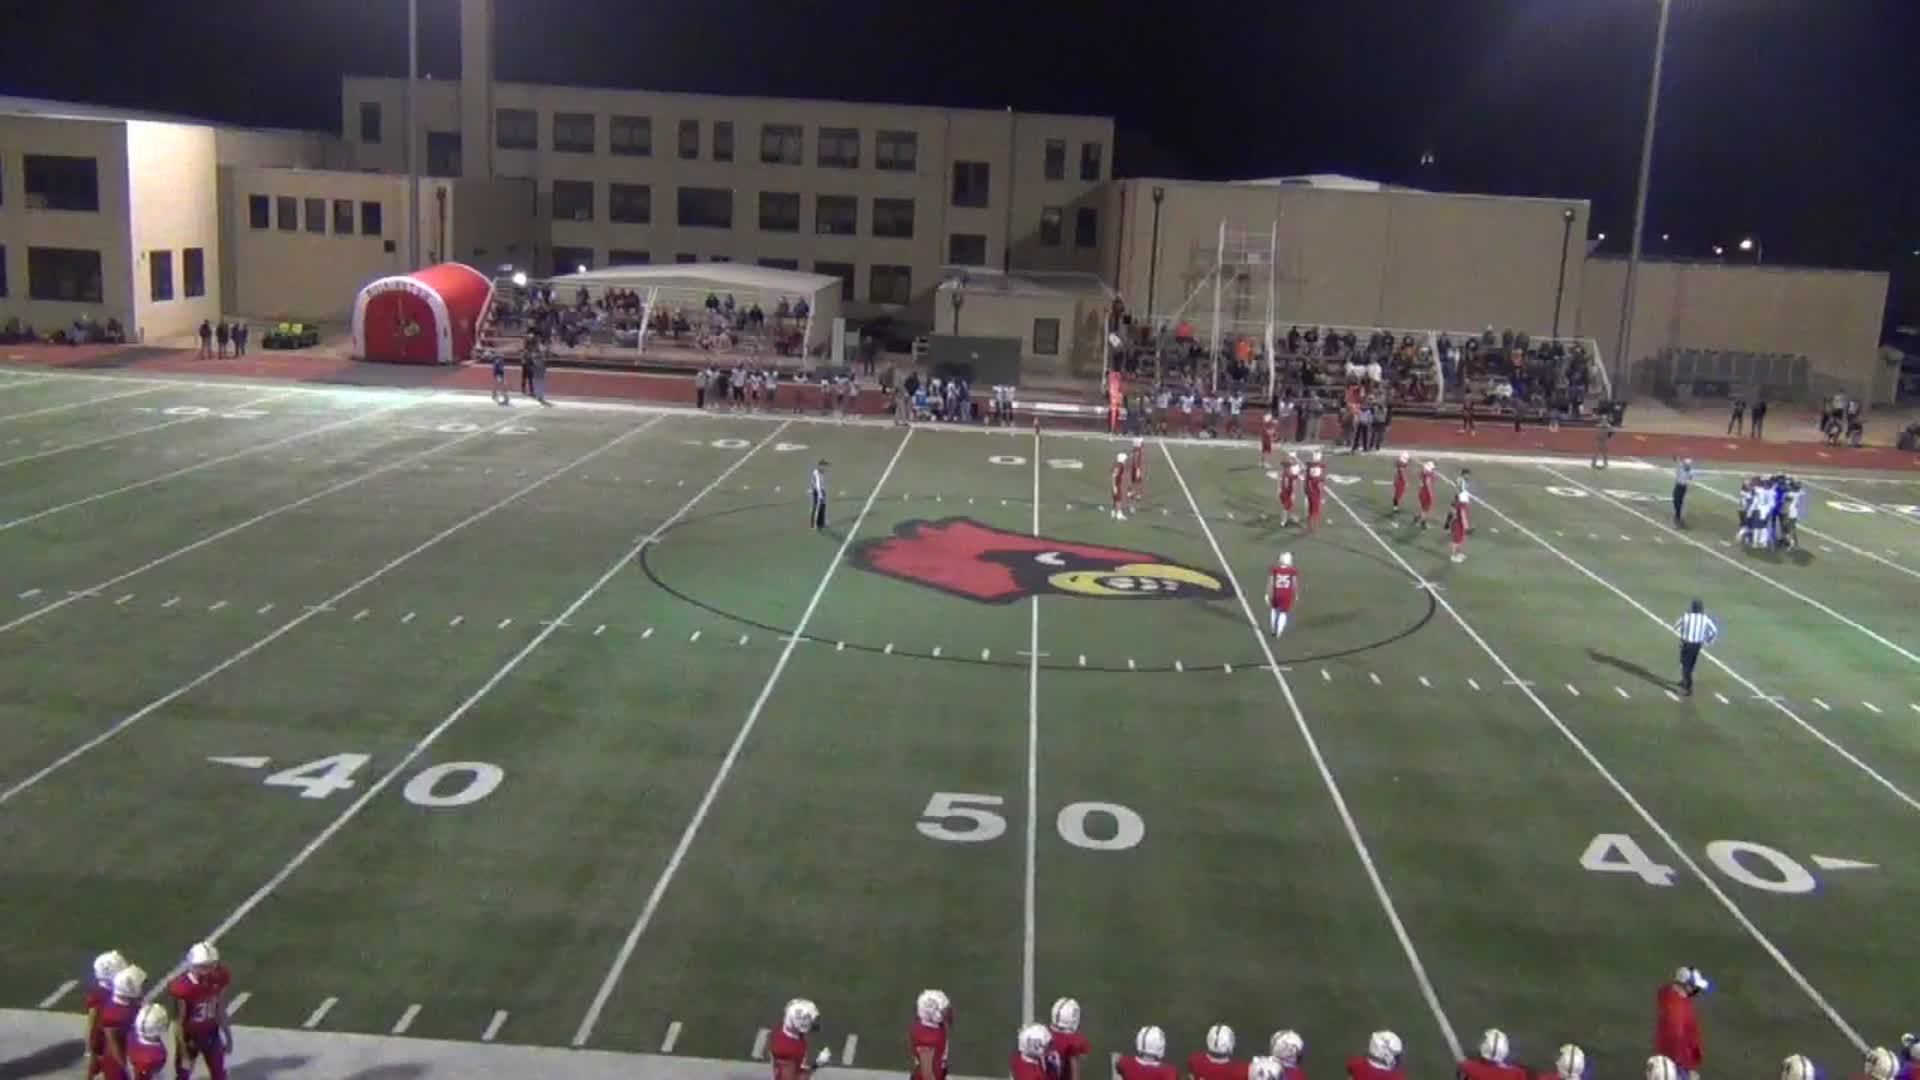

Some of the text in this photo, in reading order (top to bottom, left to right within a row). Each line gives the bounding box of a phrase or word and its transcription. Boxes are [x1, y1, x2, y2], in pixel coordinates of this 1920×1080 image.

[1275, 573, 1291, 589] 25
[264, 753, 503, 806] 40
[916, 791, 1146, 851] 50
[1579, 833, 1817, 893] 40
